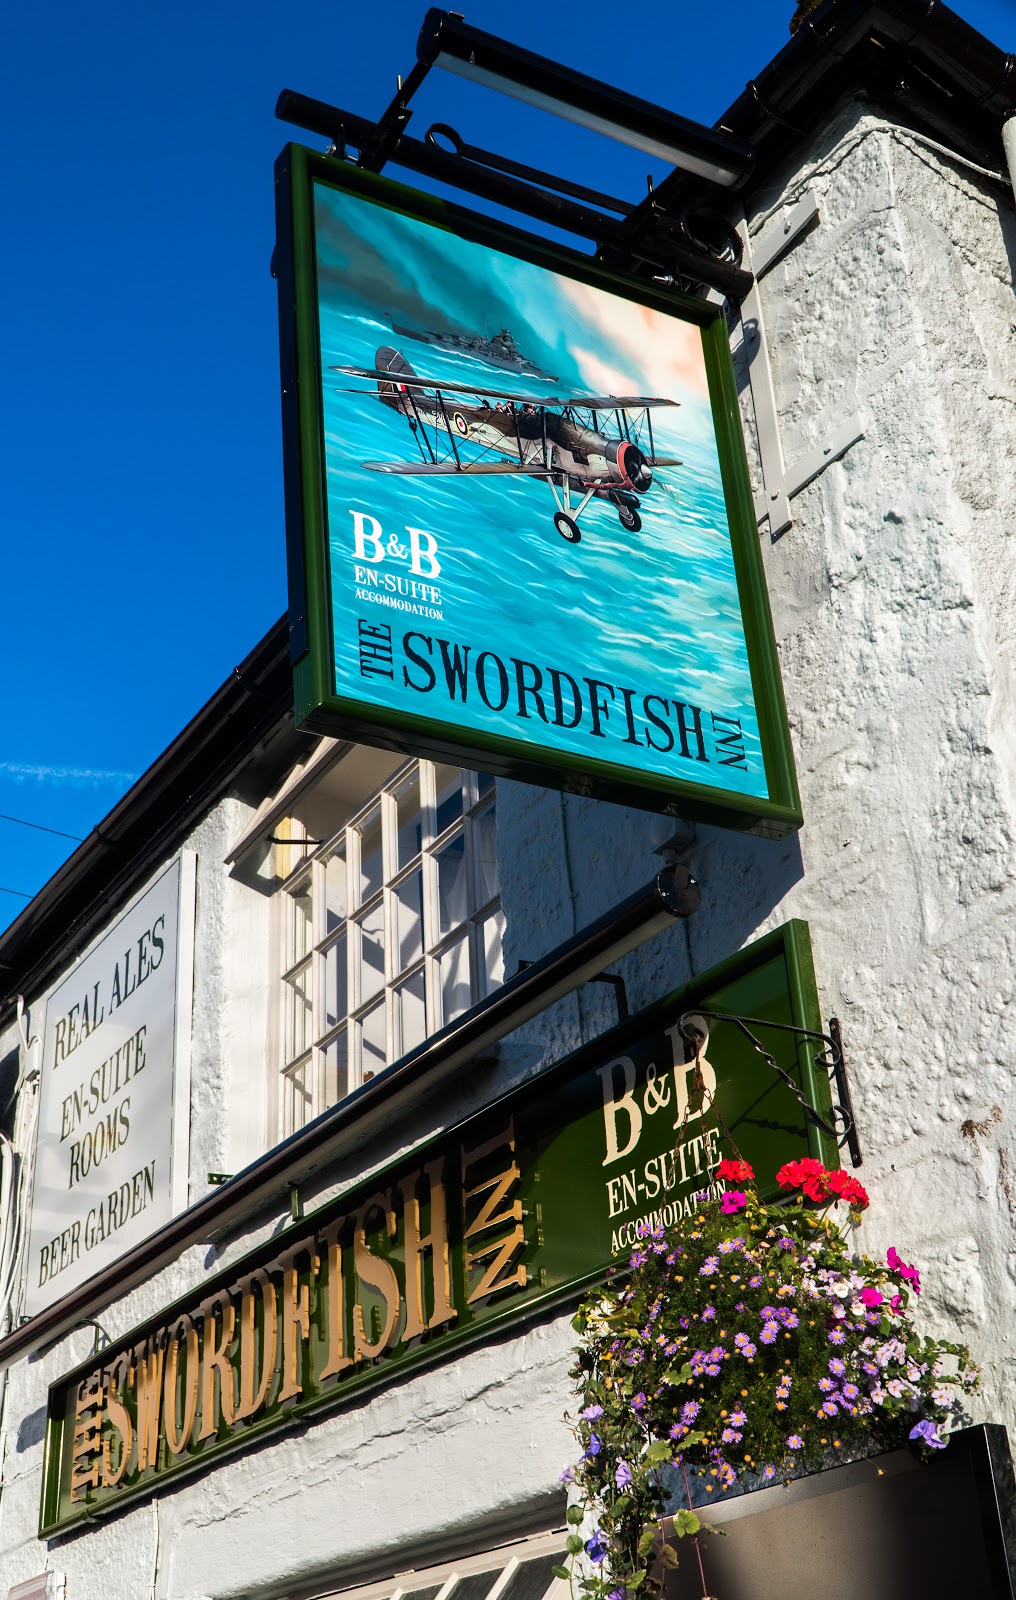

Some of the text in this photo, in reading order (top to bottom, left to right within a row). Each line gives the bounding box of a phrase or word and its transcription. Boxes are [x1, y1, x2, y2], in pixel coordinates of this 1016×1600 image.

[349, 510, 441, 579] B&B
[354, 564, 442, 606] EN-SUITE
[355, 588, 443, 621] ACCOMMODATION
[358, 618, 748, 773] THE SWORDFISH INN
[53, 914, 166, 1071] REAL ALES
[59, 1024, 148, 1143] EN-SUITE
[68, 1096, 131, 1190] ROOMS
[596, 1014, 717, 1167] B&B
[38, 1160, 156, 1289] BEER GARDEN
[606, 1127, 722, 1218] EN-SUITE
[71, 1113, 528, 1503] THE SWORDFISH INN
